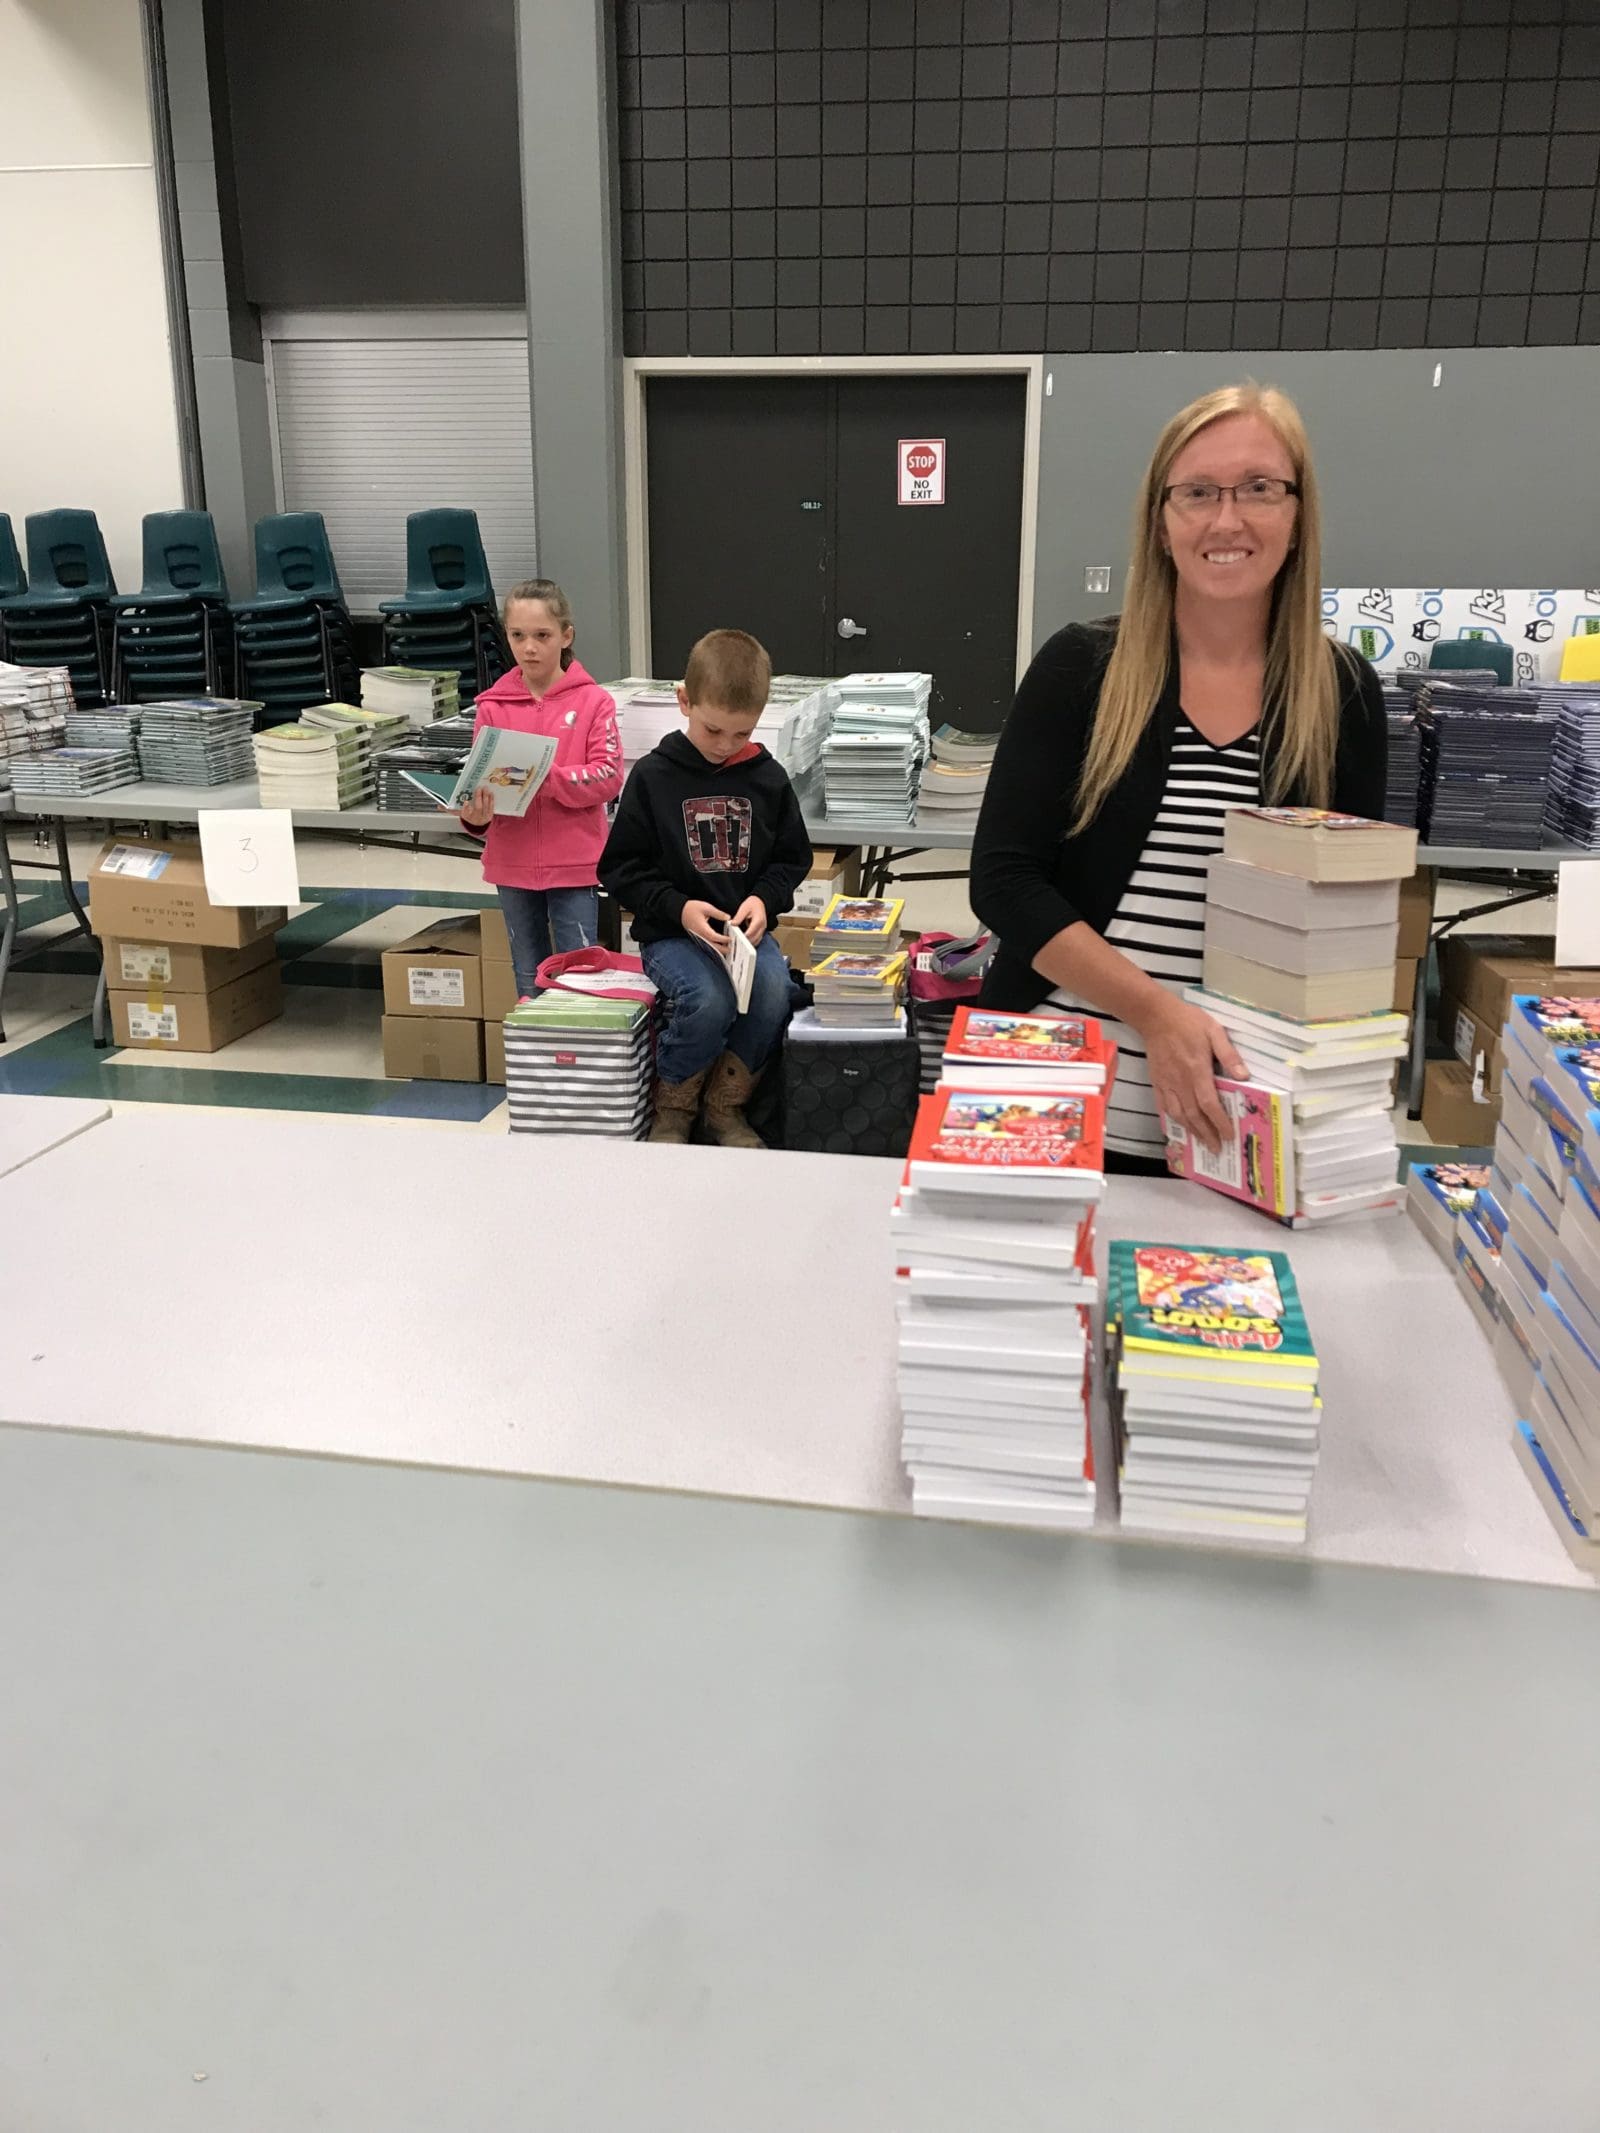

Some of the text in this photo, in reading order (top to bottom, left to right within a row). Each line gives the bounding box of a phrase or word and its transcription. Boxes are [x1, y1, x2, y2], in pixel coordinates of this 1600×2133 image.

[908, 455, 935, 469] STOP
[913, 479, 930, 489] NO
[910, 489, 933, 500] EXIT
[238, 837, 259, 872] 3
